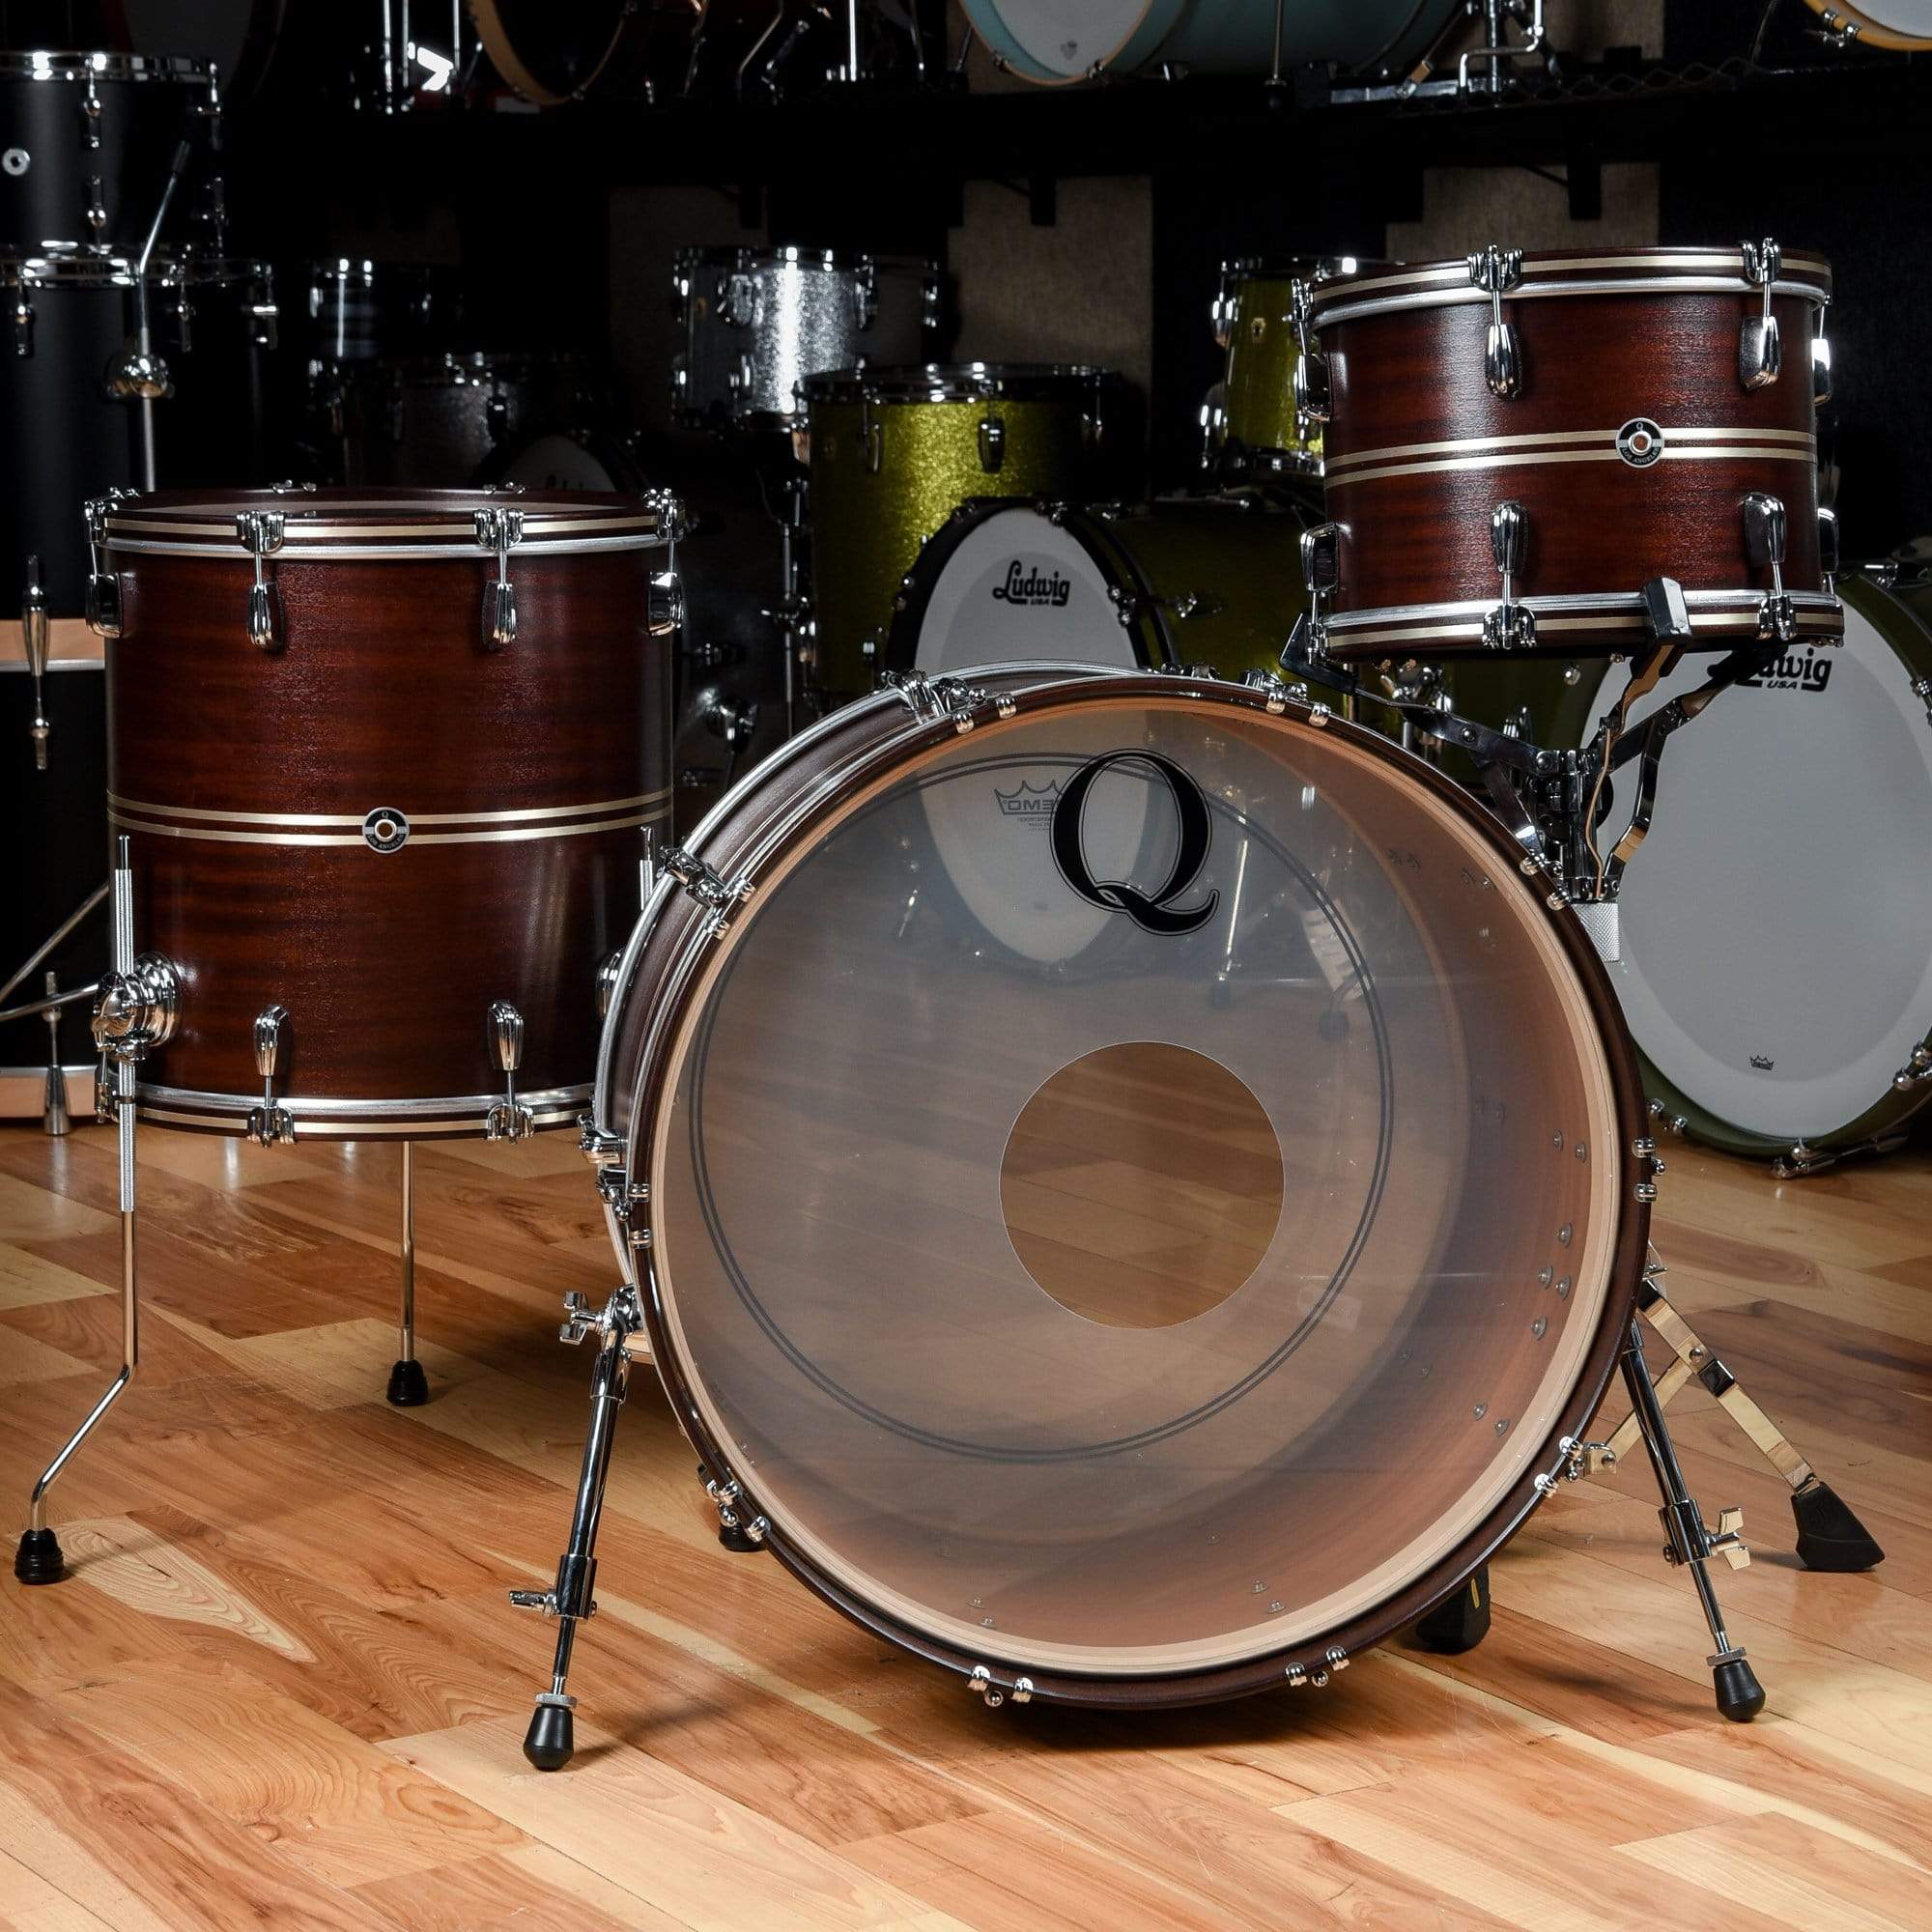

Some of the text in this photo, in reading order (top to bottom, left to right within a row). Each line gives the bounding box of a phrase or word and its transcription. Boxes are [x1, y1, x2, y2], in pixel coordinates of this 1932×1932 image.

[1635, 421, 1644, 431] Q
[1621, 447, 1661, 464] LOS ANGELES
[992, 559, 1070, 607] Ludwig
[1735, 647, 1833, 693] wig
[1767, 680, 1797, 689] USA
[1050, 749, 1220, 936] Q
